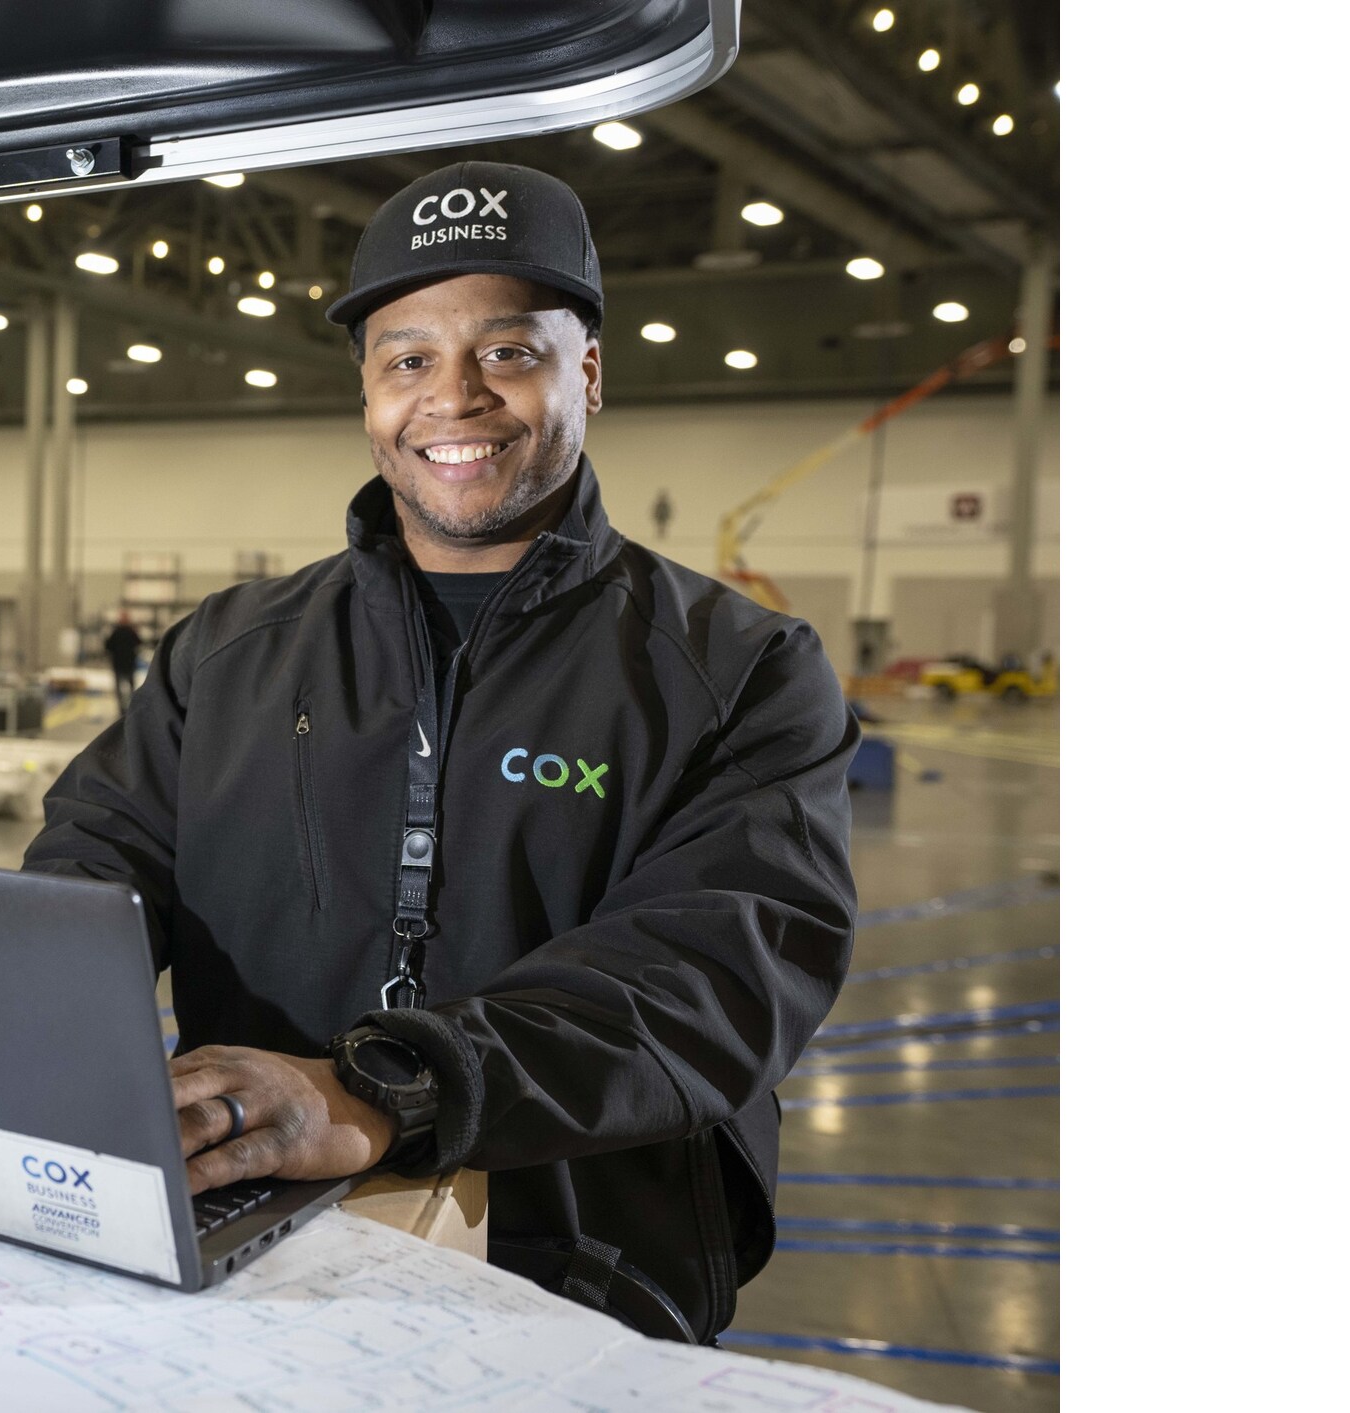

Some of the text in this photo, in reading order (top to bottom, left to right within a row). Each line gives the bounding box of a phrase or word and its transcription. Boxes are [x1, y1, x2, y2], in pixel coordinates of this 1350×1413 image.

[412, 187, 508, 226] COX
[411, 224, 507, 251] BUSINESS
[501, 747, 609, 799] COX
[22, 1155, 93, 1192] COX
[27, 1182, 96, 1209] BUSINESS
[32, 1204, 100, 1229] ADVANCED
[33, 1213, 100, 1238] CONVENTION
[35, 1223, 79, 1241] SERVICES
